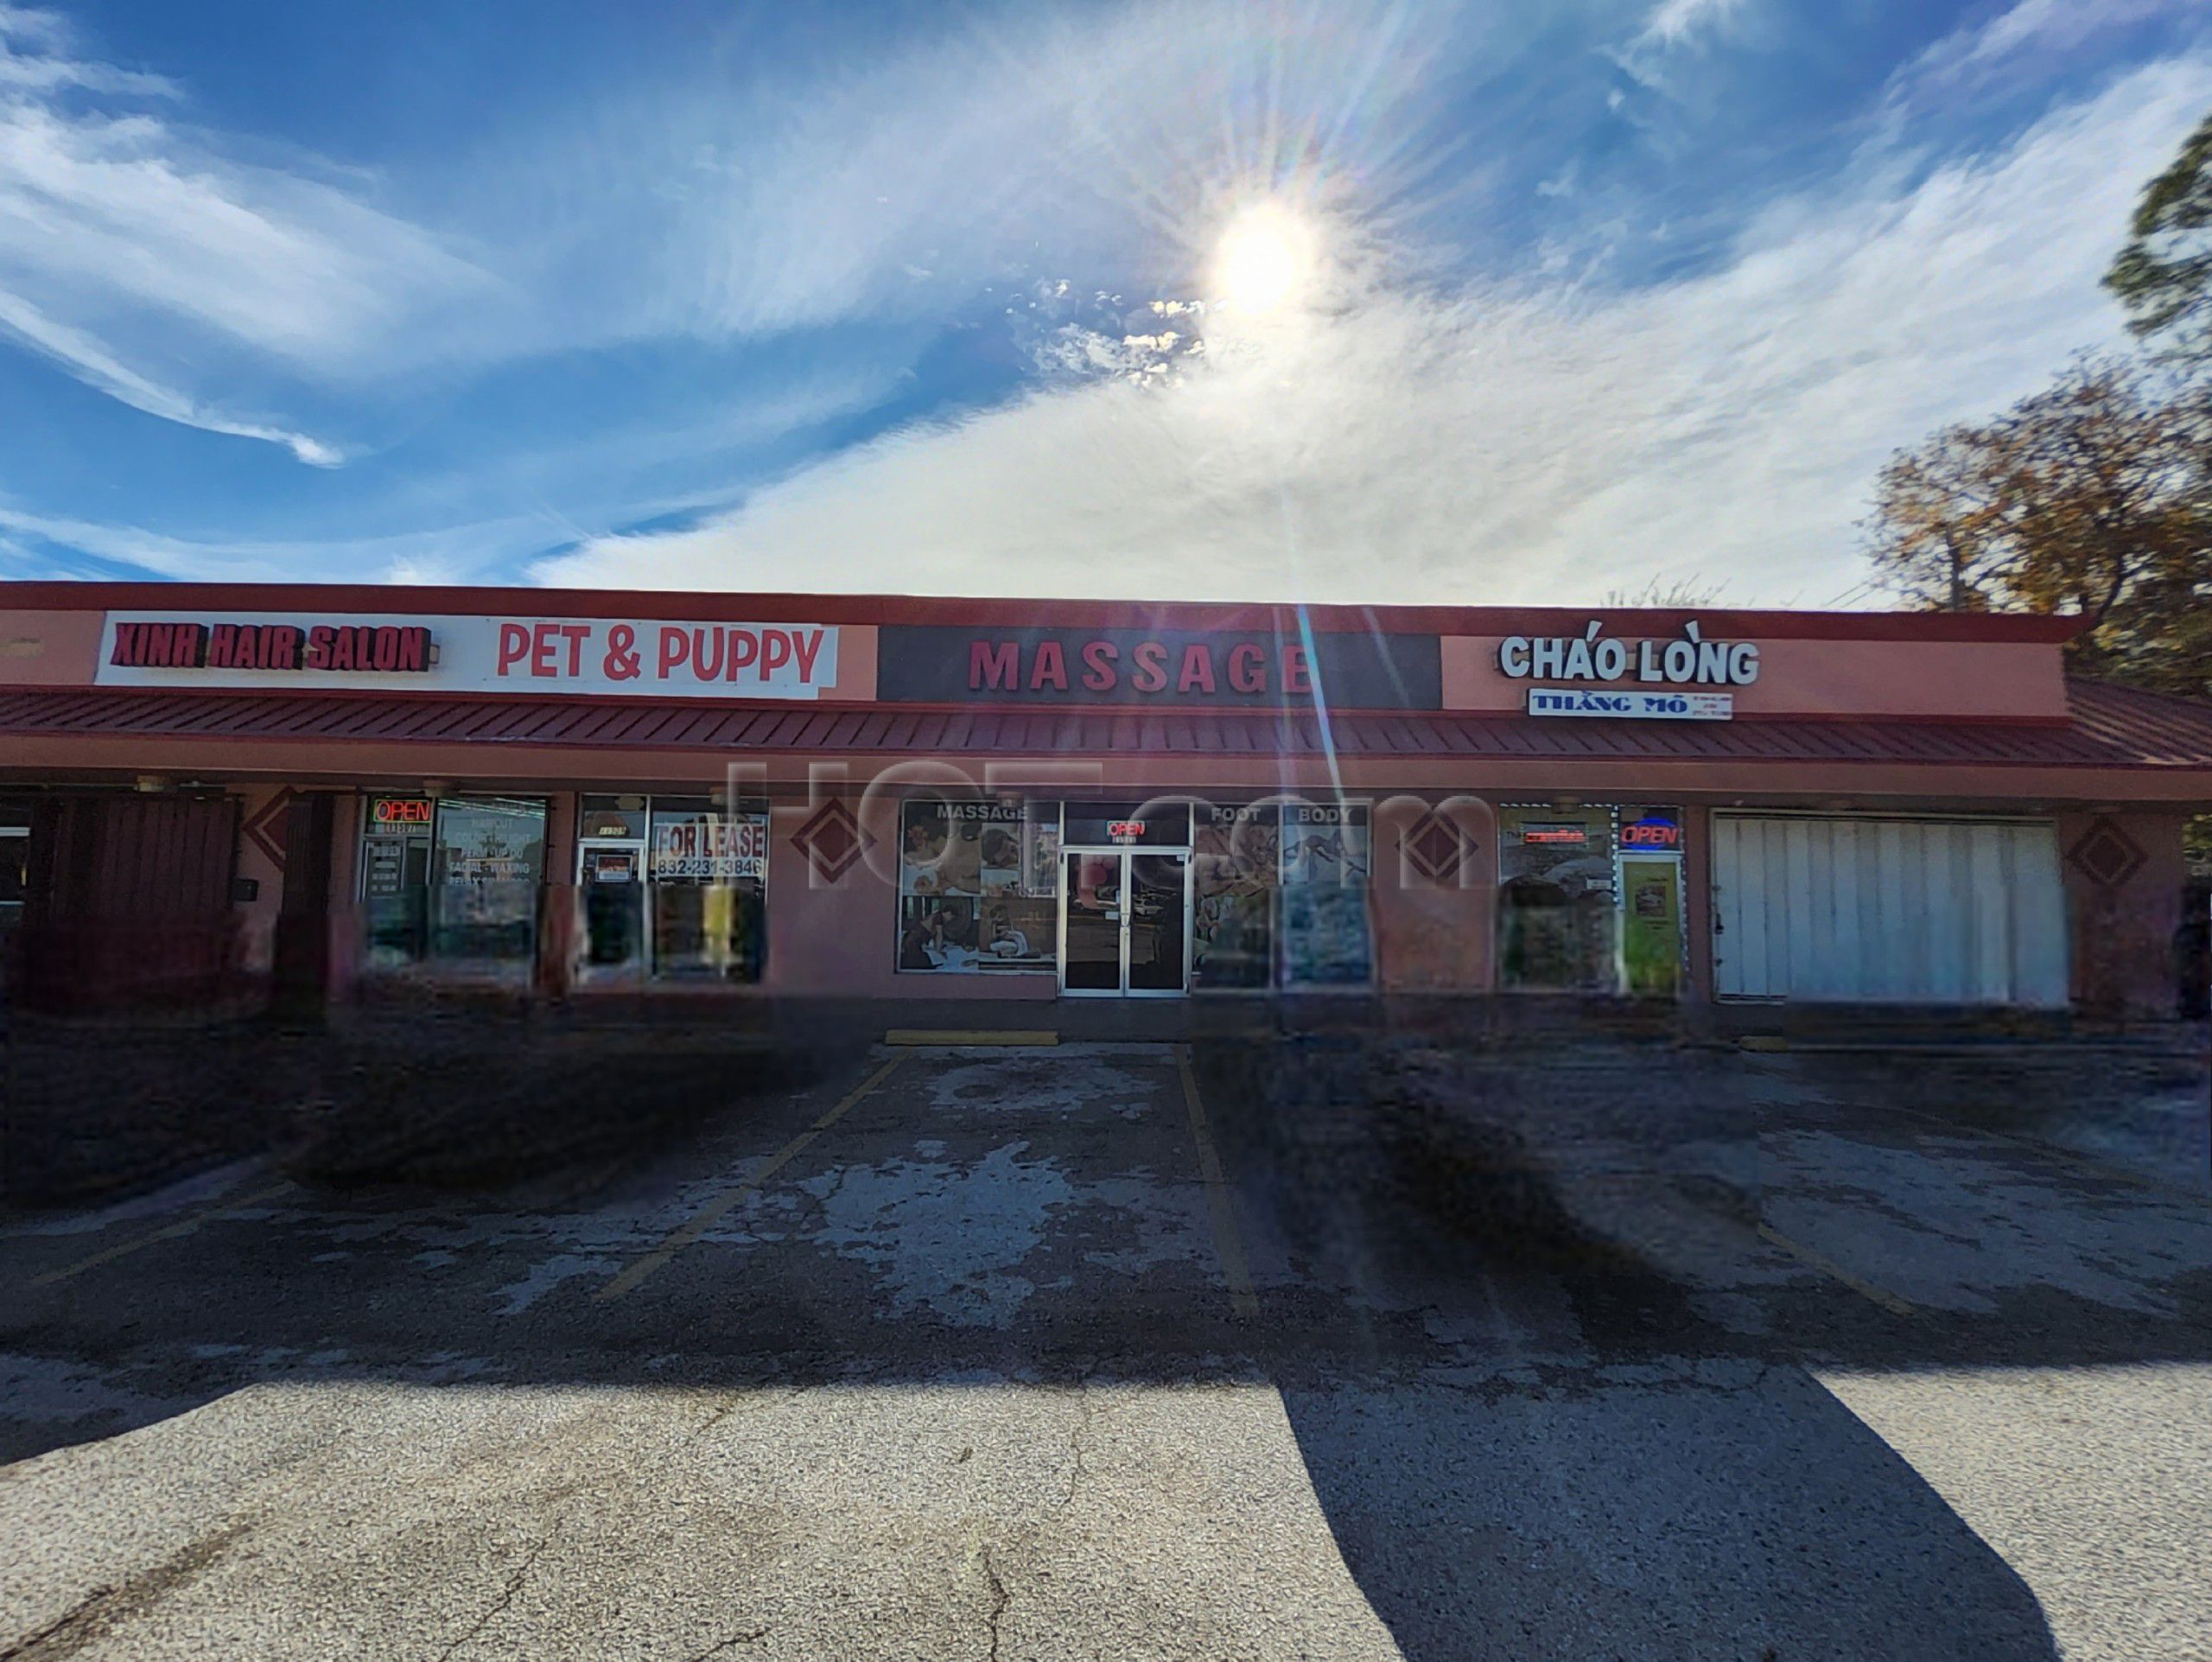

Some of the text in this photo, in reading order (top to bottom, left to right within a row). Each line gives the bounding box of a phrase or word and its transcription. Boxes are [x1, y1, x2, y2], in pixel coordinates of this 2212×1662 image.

[111, 622, 431, 672] XINH HAIR SALON
[498, 623, 825, 684] PET & PUPPY
[968, 640, 1319, 693] MASSAGE
[376, 800, 431, 821] OPEN
[937, 804, 1028, 820] MASSAGE
[1211, 807, 1262, 822] FOOT
[1298, 807, 1352, 823] BODY
[1109, 822, 1144, 837] OPEN
[1621, 825, 1679, 844] OPEN
[658, 825, 765, 858] FOR LEASE
[658, 858, 763, 876] 832-231-3846
